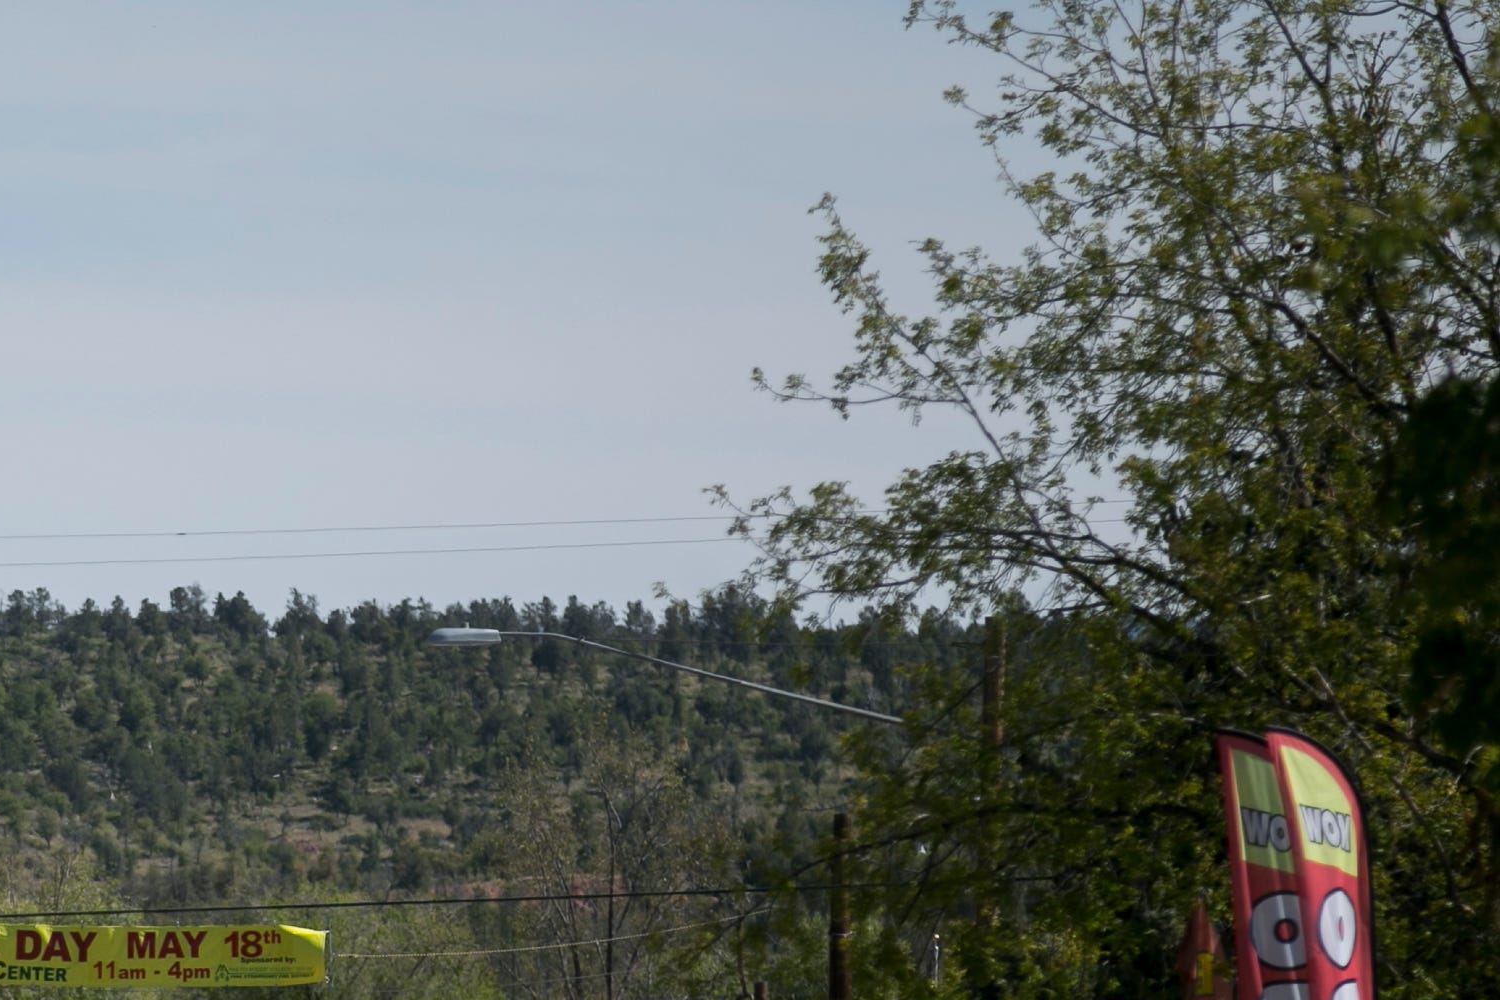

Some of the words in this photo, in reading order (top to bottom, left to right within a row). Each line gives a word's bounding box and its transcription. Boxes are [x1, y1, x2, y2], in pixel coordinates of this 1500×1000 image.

[16, 930, 98, 963] DAY
[127, 930, 208, 960] MAY
[224, 930, 281, 958] 18th
[93, 961, 146, 980] 11am
[168, 961, 211, 982] 4pm
